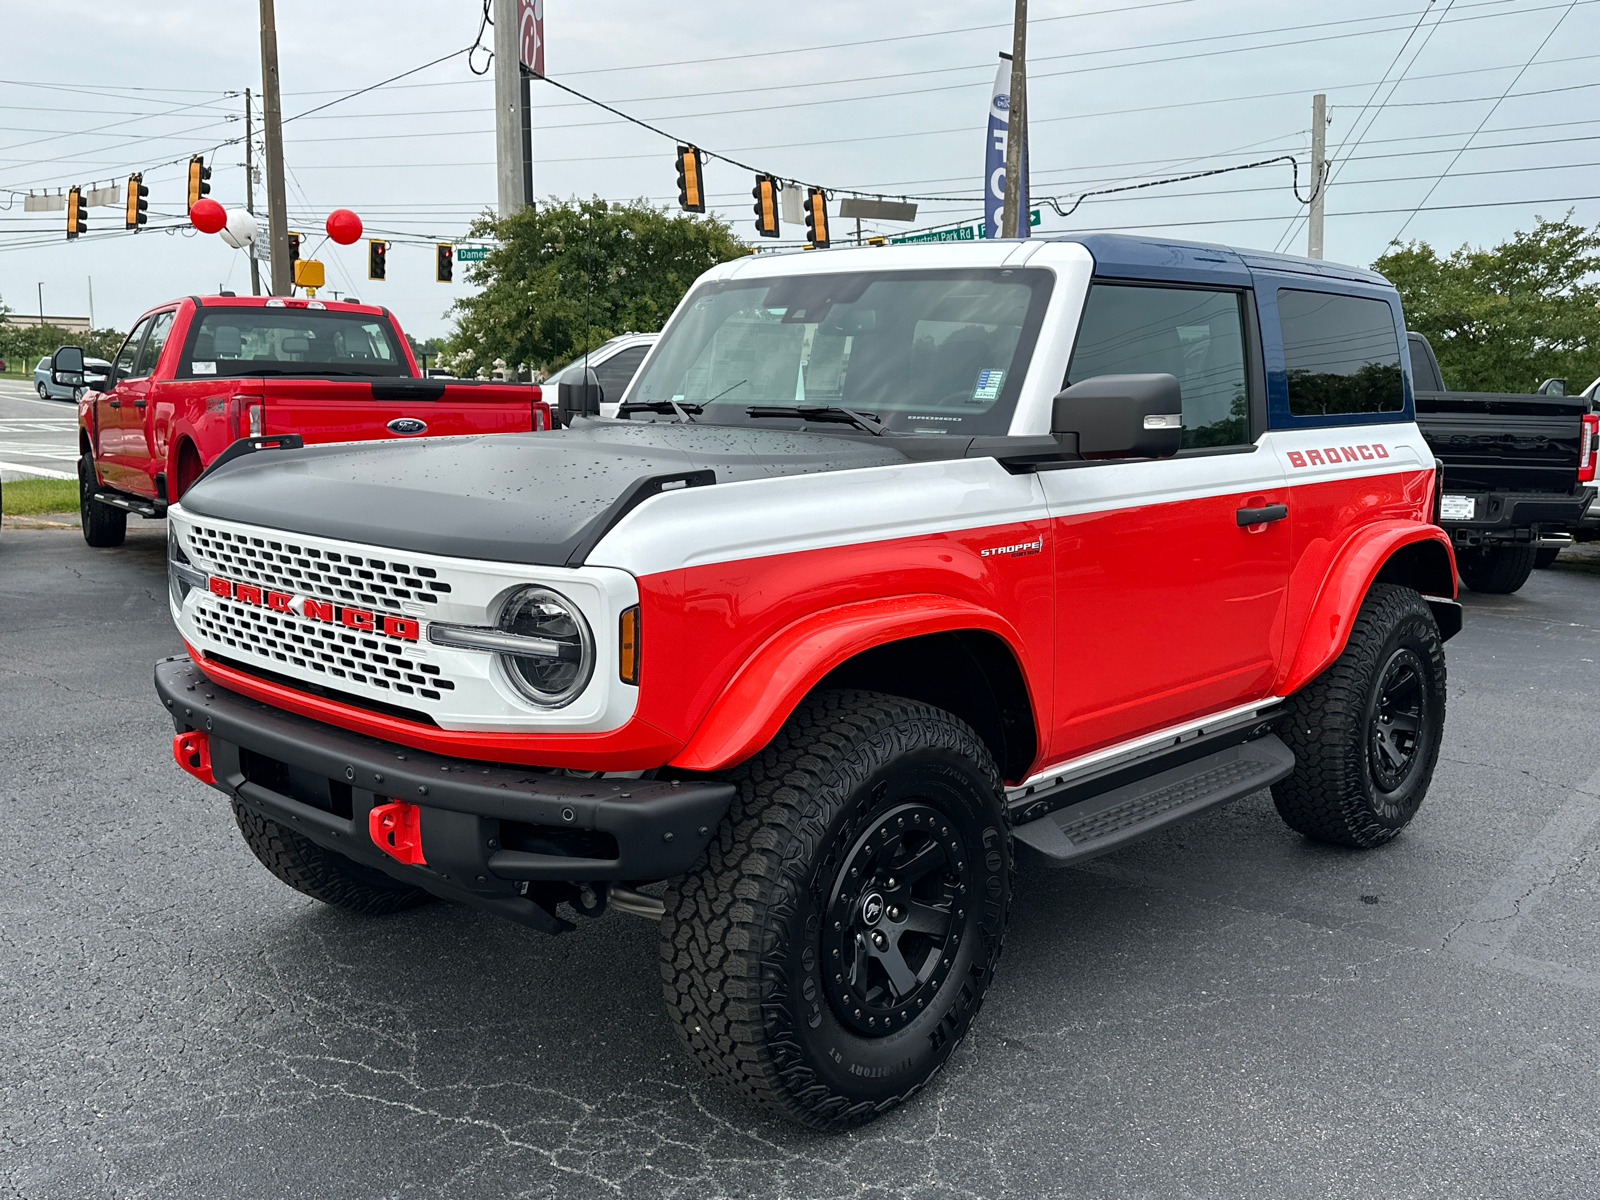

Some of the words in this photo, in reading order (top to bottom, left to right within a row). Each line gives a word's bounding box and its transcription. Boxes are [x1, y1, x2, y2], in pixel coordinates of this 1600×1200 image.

[940, 232, 958, 241] Park
[960, 230, 971, 239] Rd
[1286, 444, 1389, 468] BRONCO
[981, 541, 1040, 557] STROPPE
[210, 576, 419, 640] BRONCO
[827, 1046, 844, 1064] RT
[848, 1057, 914, 1078] TERRITORY
